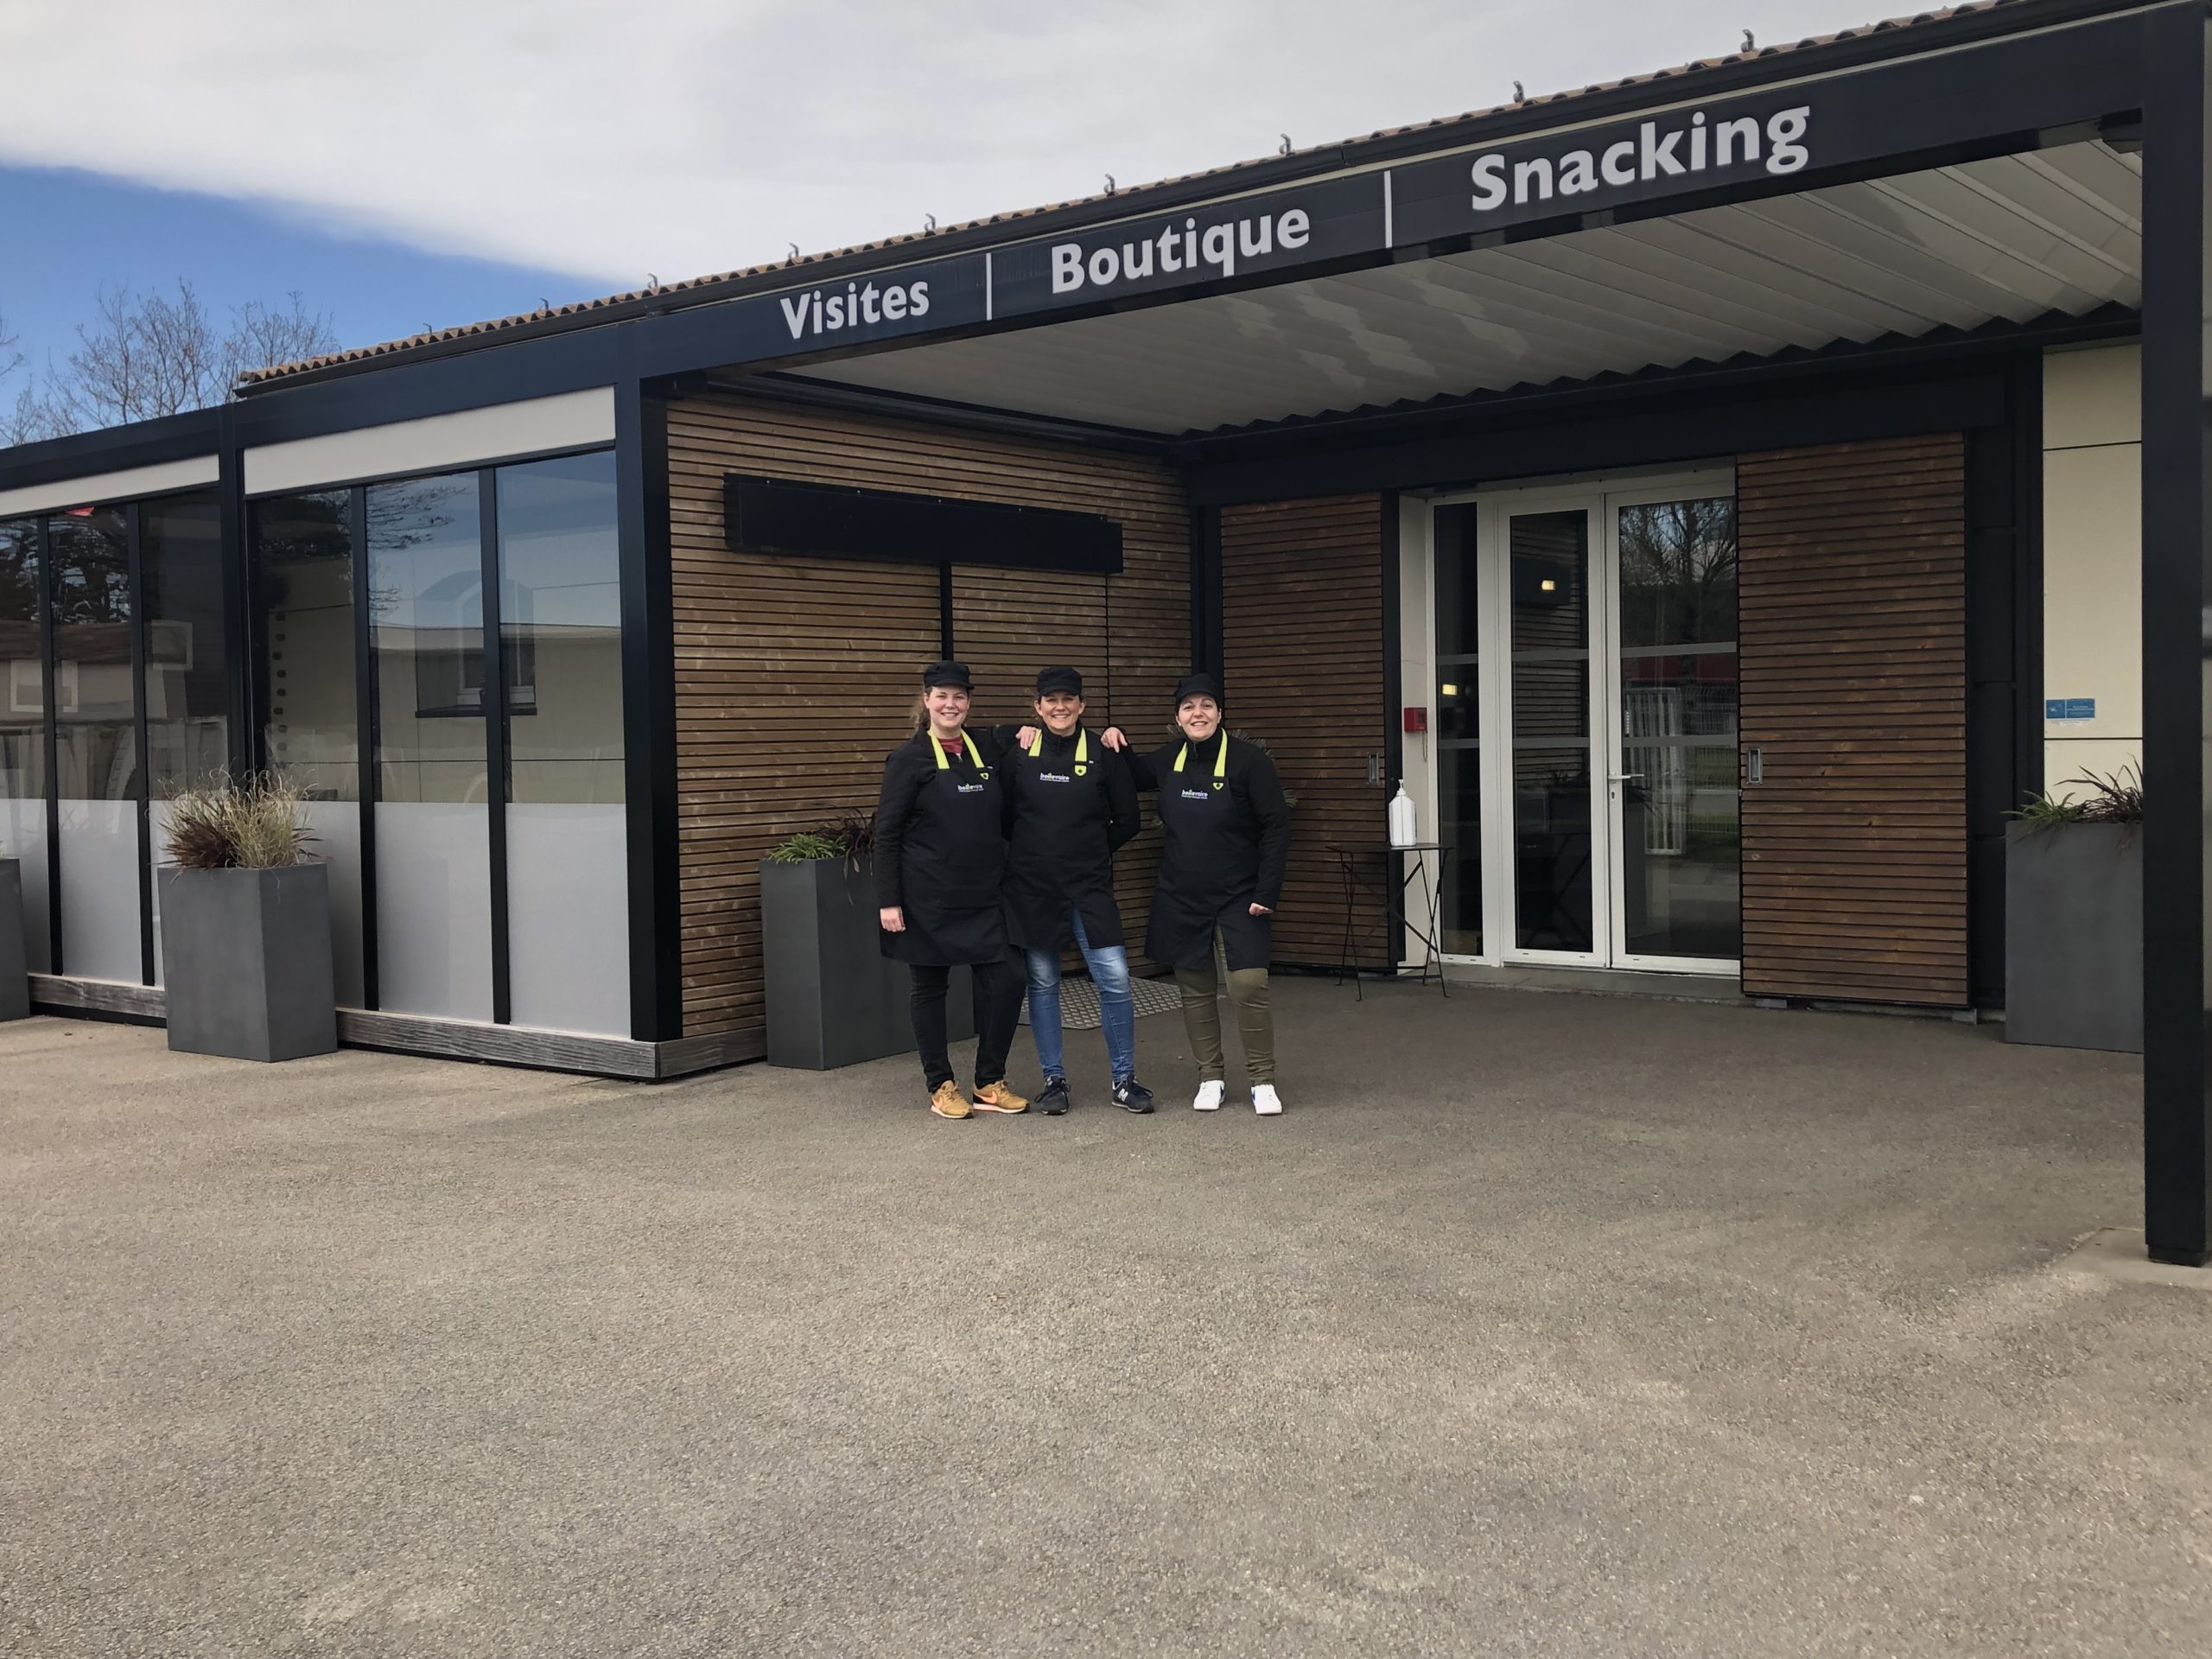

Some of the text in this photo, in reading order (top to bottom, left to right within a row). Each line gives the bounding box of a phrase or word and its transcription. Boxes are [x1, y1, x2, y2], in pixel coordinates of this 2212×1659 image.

[779, 106, 1810, 340] Visites Boutique Snacking
